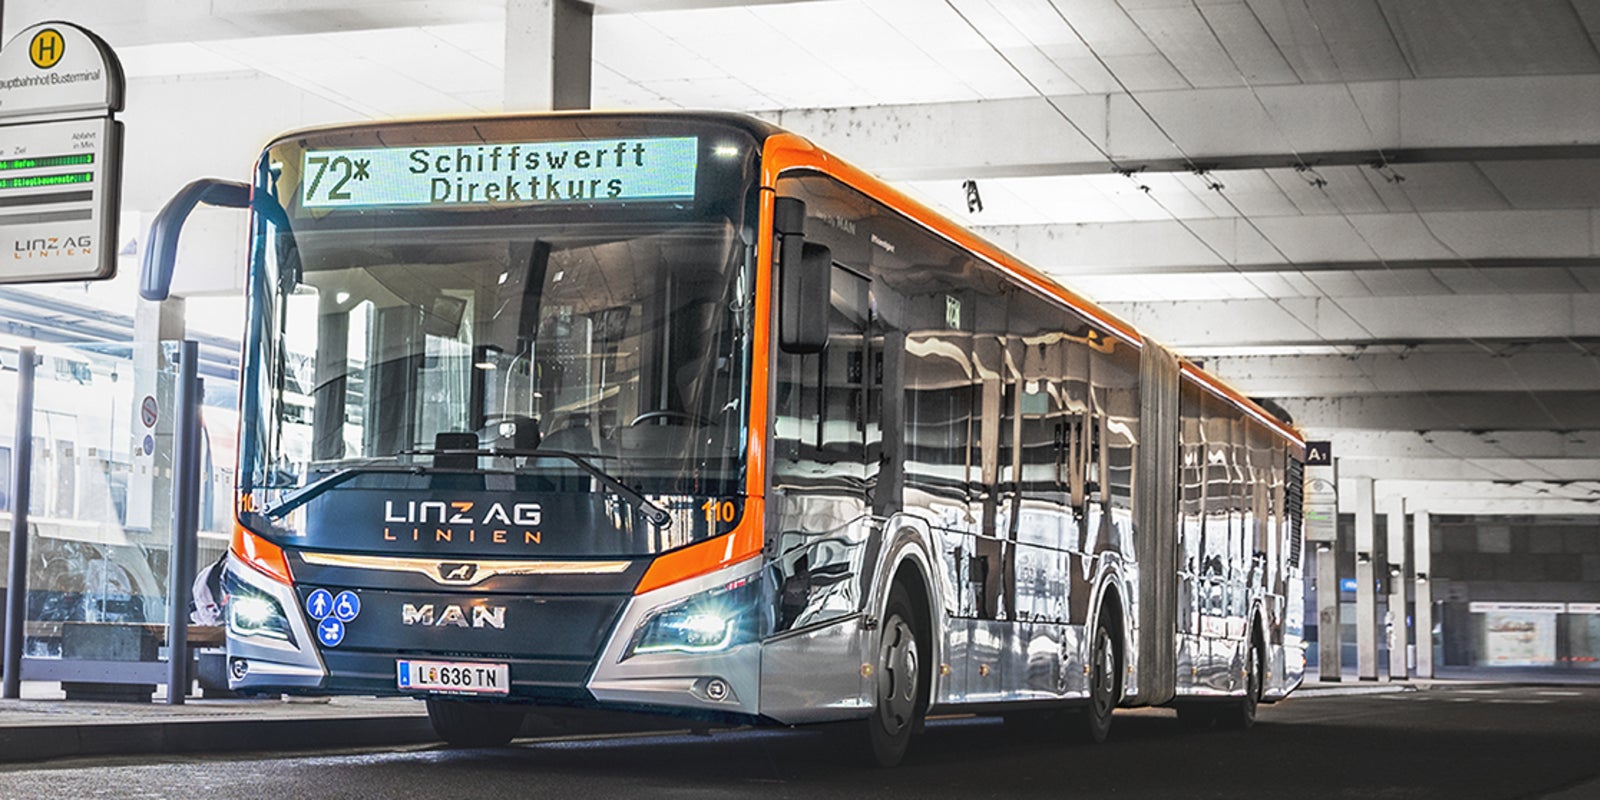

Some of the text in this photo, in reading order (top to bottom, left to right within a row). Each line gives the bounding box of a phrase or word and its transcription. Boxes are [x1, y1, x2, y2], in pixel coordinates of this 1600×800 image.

[409, 142, 646, 174] Schiffswerft
[431, 174, 623, 203] Direktkurs
[14, 248, 91, 260] LINIEN
[15, 236, 91, 251] LINZ AG
[385, 501, 541, 526] LINZ AG
[701, 500, 734, 523] 110
[384, 528, 541, 544] LINIEN
[402, 603, 506, 629] MAN
[419, 666, 496, 687] L 636 TN
